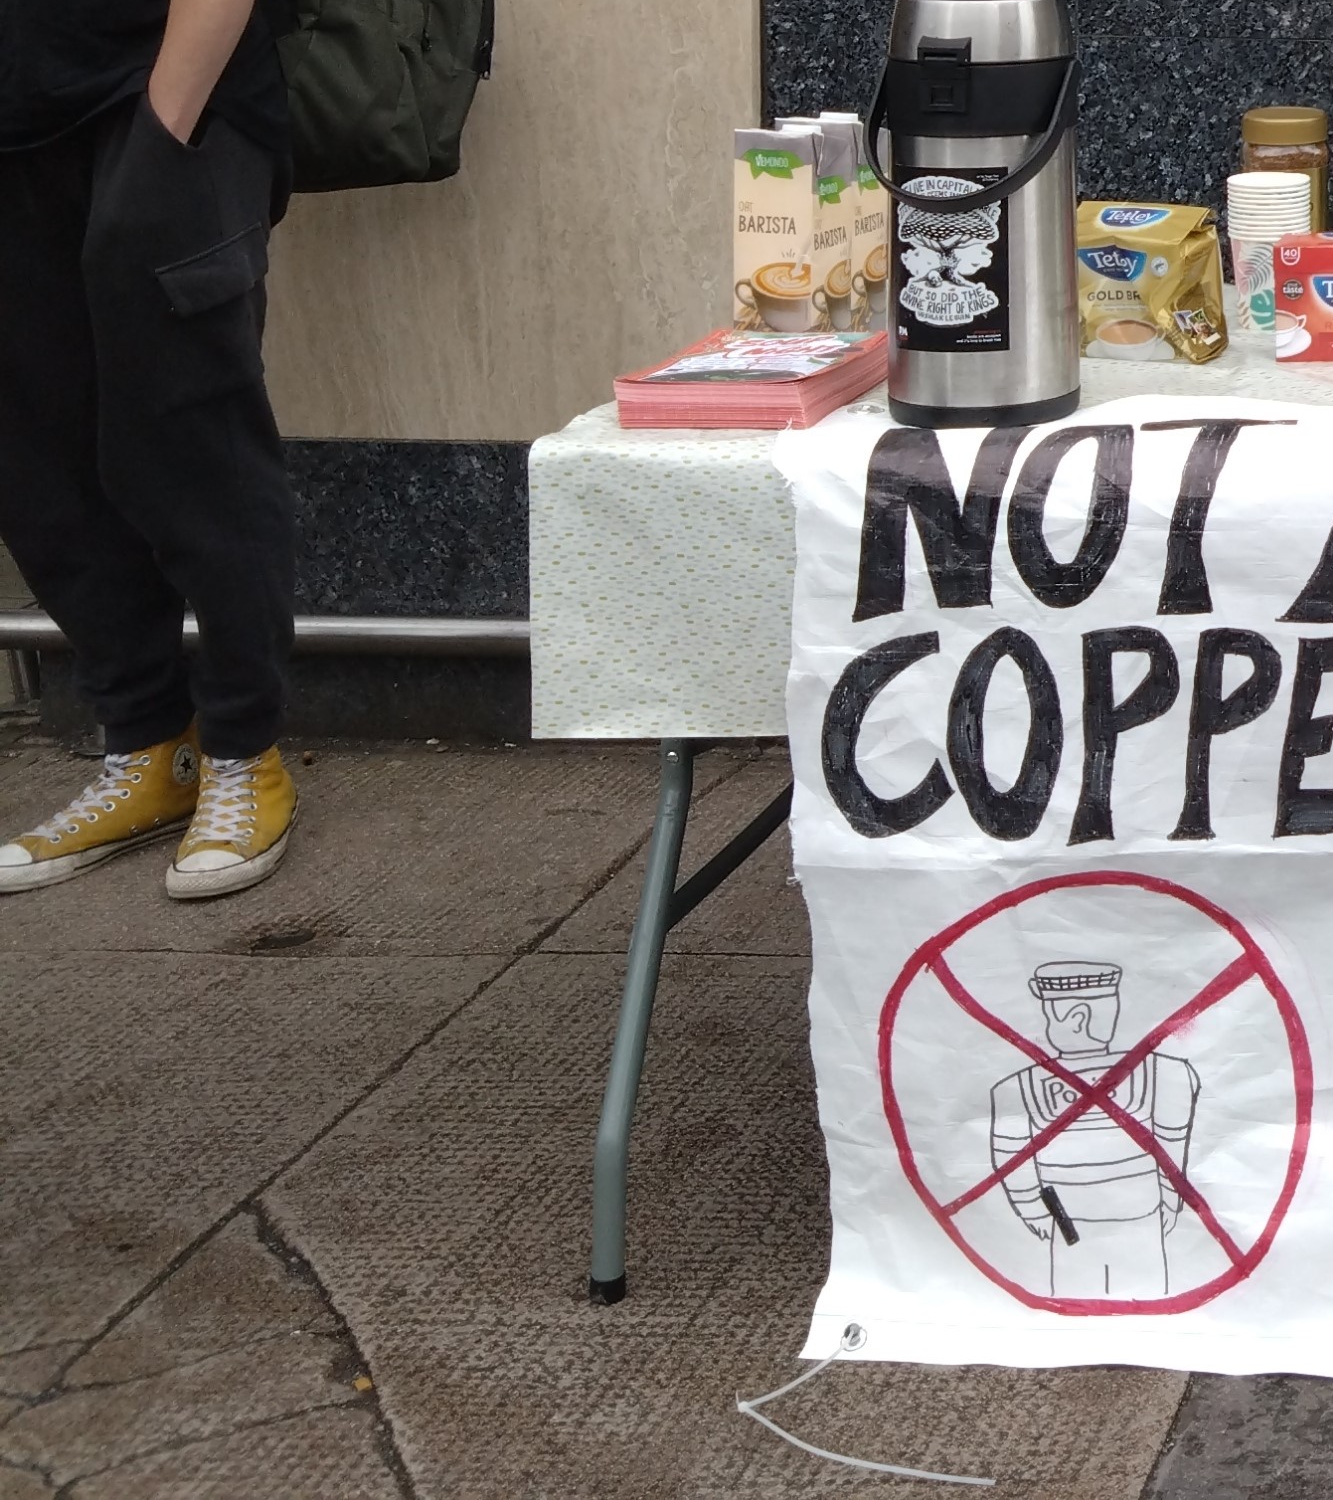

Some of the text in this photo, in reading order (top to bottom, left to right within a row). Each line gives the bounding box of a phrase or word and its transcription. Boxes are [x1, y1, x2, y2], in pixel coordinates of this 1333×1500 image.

[738, 215, 797, 235] BARISTA
[854, 212, 885, 237] BARISTA
[1106, 209, 1159, 224] Tetley
[813, 226, 848, 251] BARISTA
[1283, 248, 1297, 258] 40
[902, 293, 995, 314] DIVINE RIGHT OF KINGS
[908, 284, 983, 303] BUT SO DID THE
[1087, 290, 1124, 302] GOLD
[851, 417, 1298, 624] NOT
